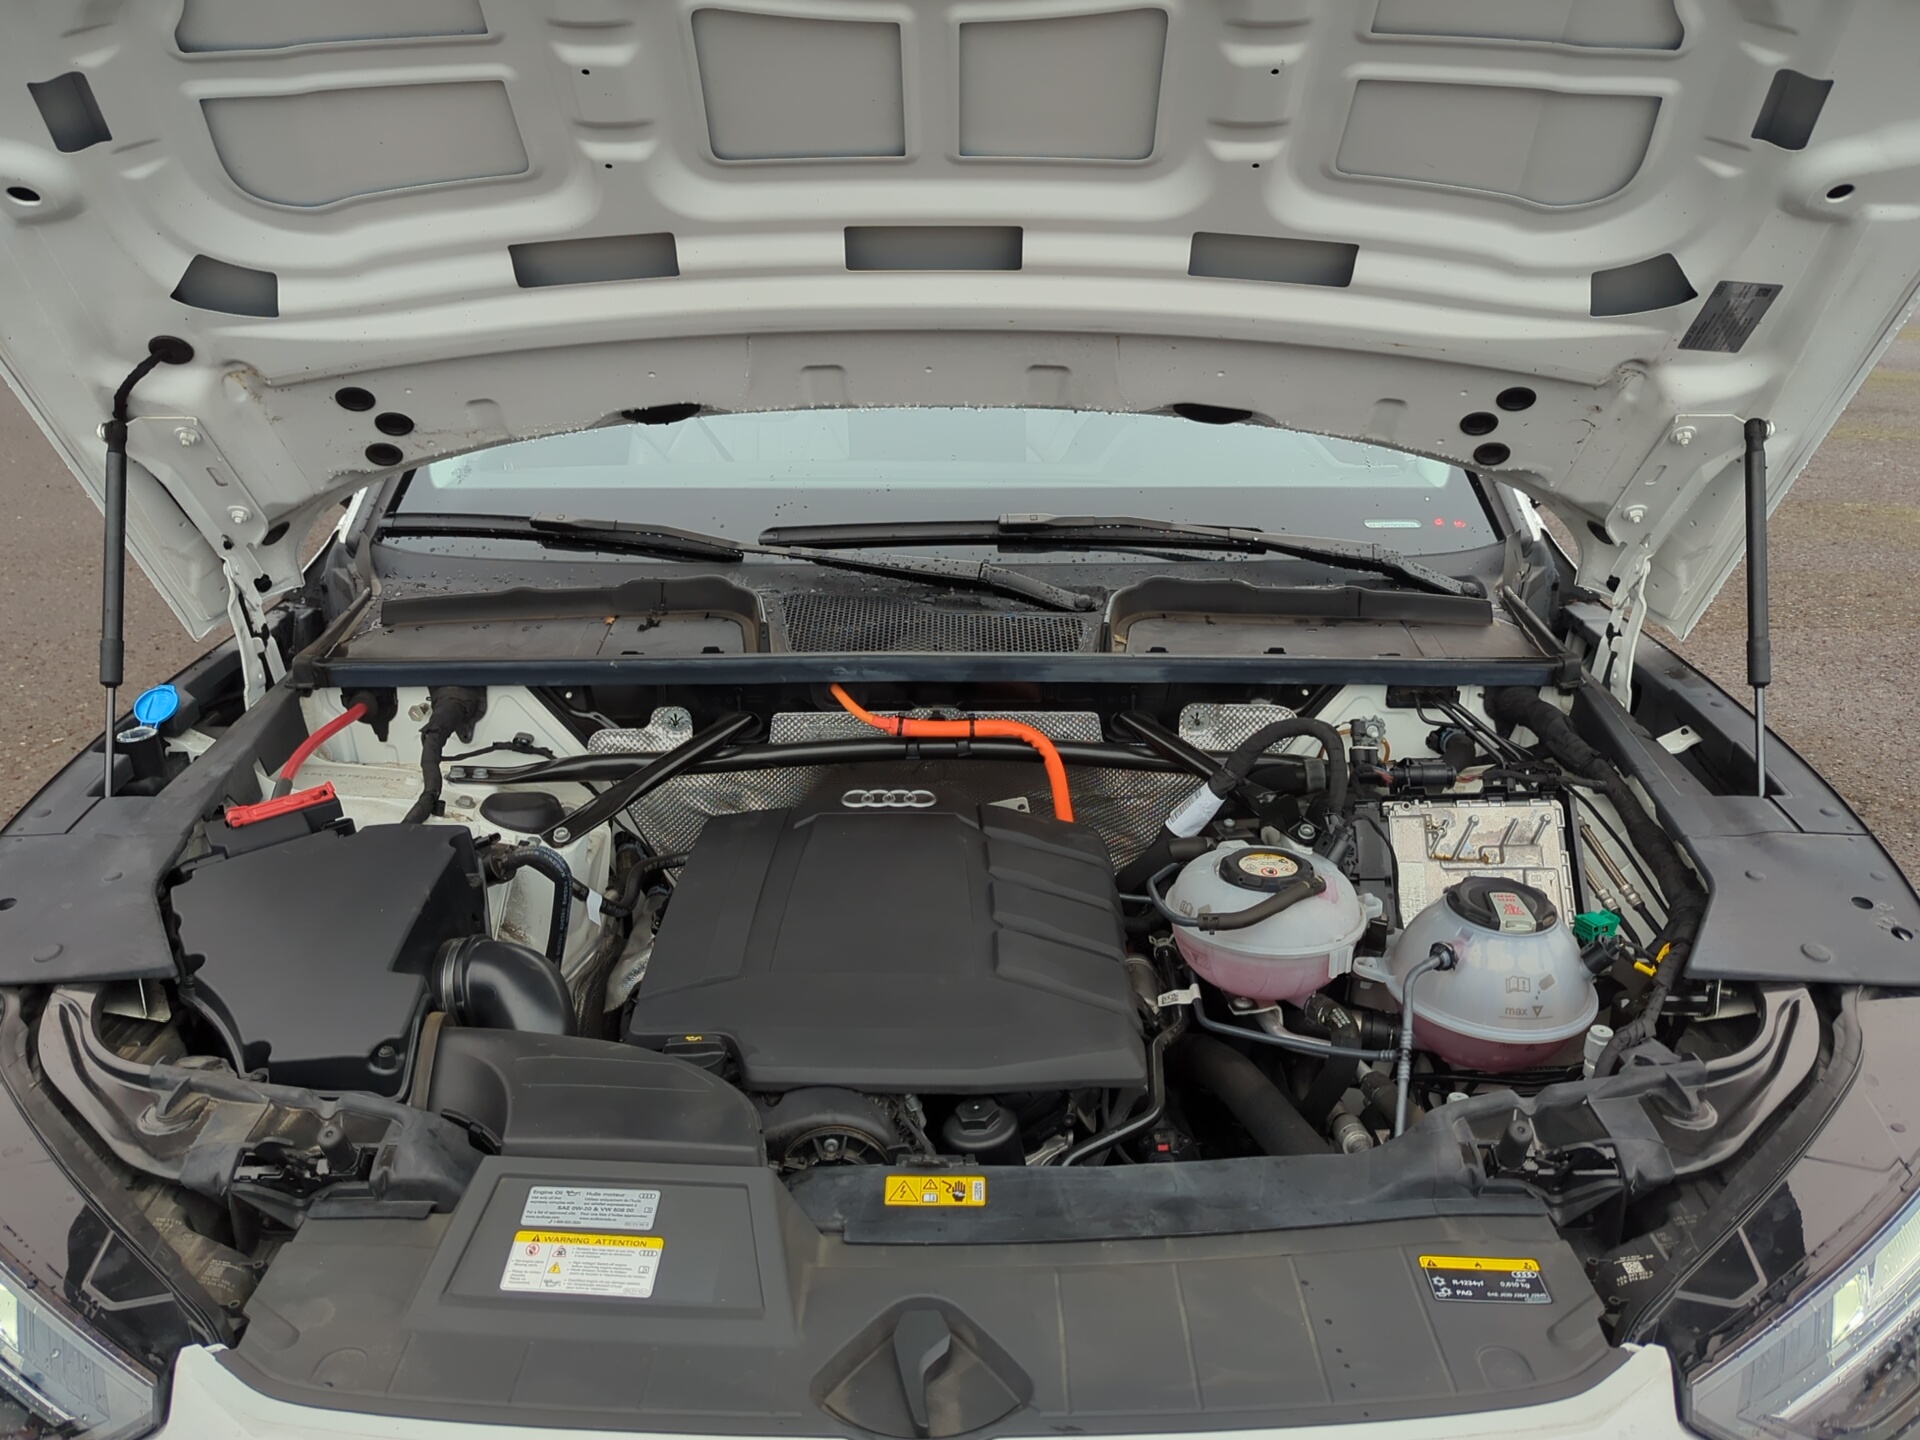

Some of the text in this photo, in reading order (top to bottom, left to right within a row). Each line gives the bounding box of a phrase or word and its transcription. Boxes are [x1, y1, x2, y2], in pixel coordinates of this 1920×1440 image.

[1505, 1006, 1528, 1016] max
[544, 1236, 648, 1247] WARNING ATTENTION
